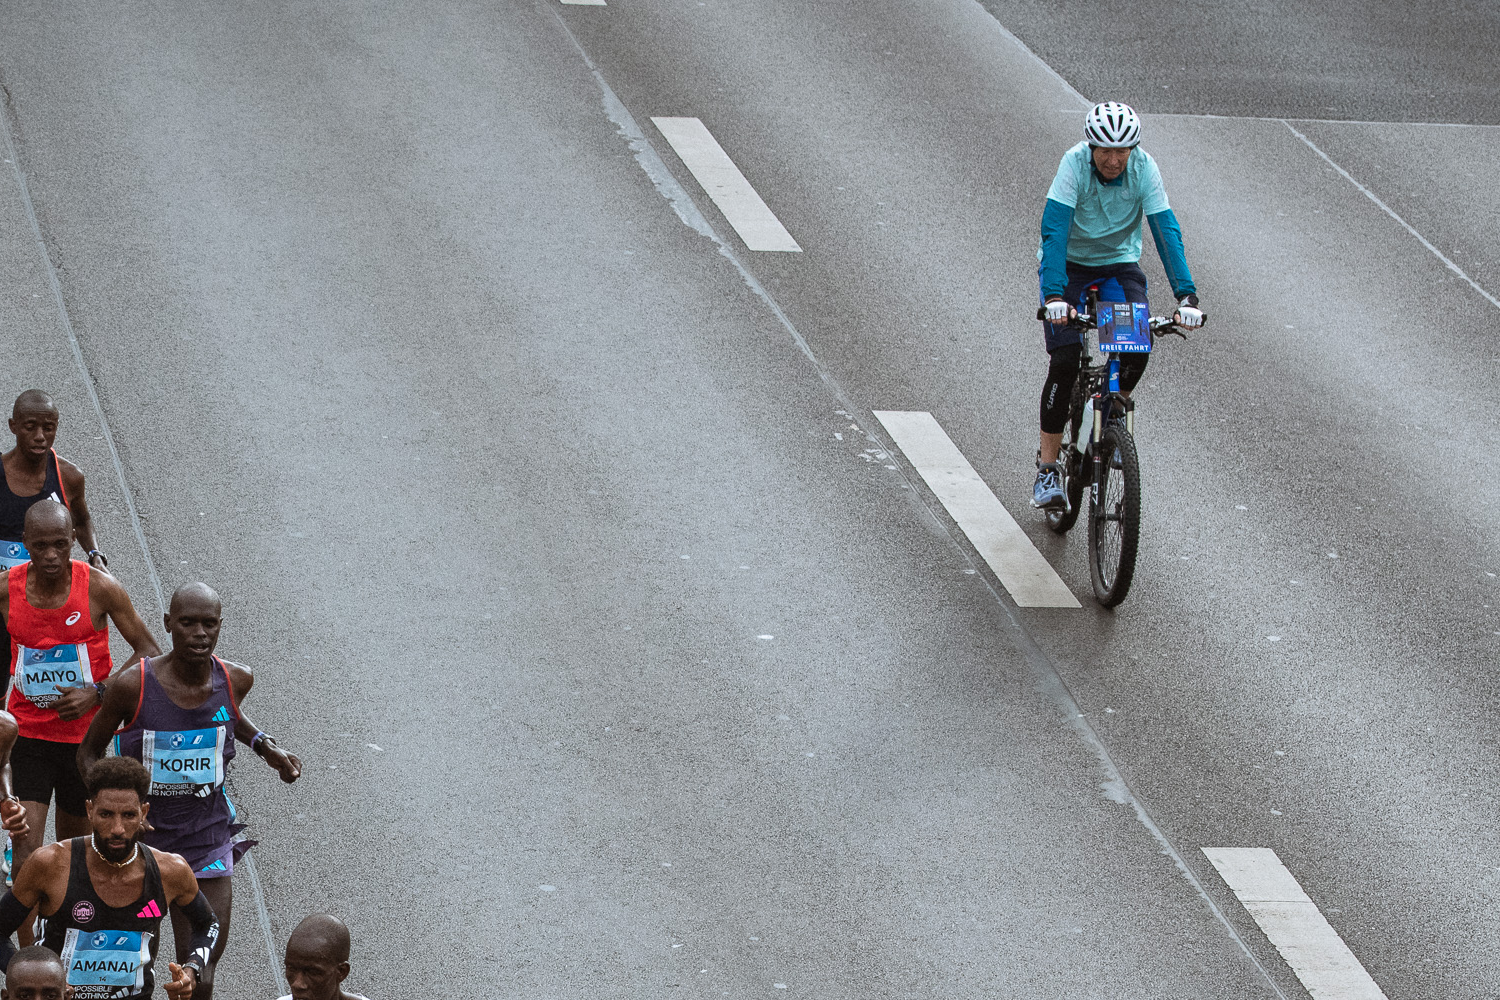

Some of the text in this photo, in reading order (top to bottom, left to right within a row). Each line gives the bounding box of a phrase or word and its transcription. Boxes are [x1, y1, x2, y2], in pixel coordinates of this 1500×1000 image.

[1125, 344, 1149, 352] FAHRT
[26, 670, 77, 685] MAIYO
[160, 757, 211, 772] KORIR
[160, 789, 194, 797] NOTHING
[74, 992, 110, 1000] NOTHING
